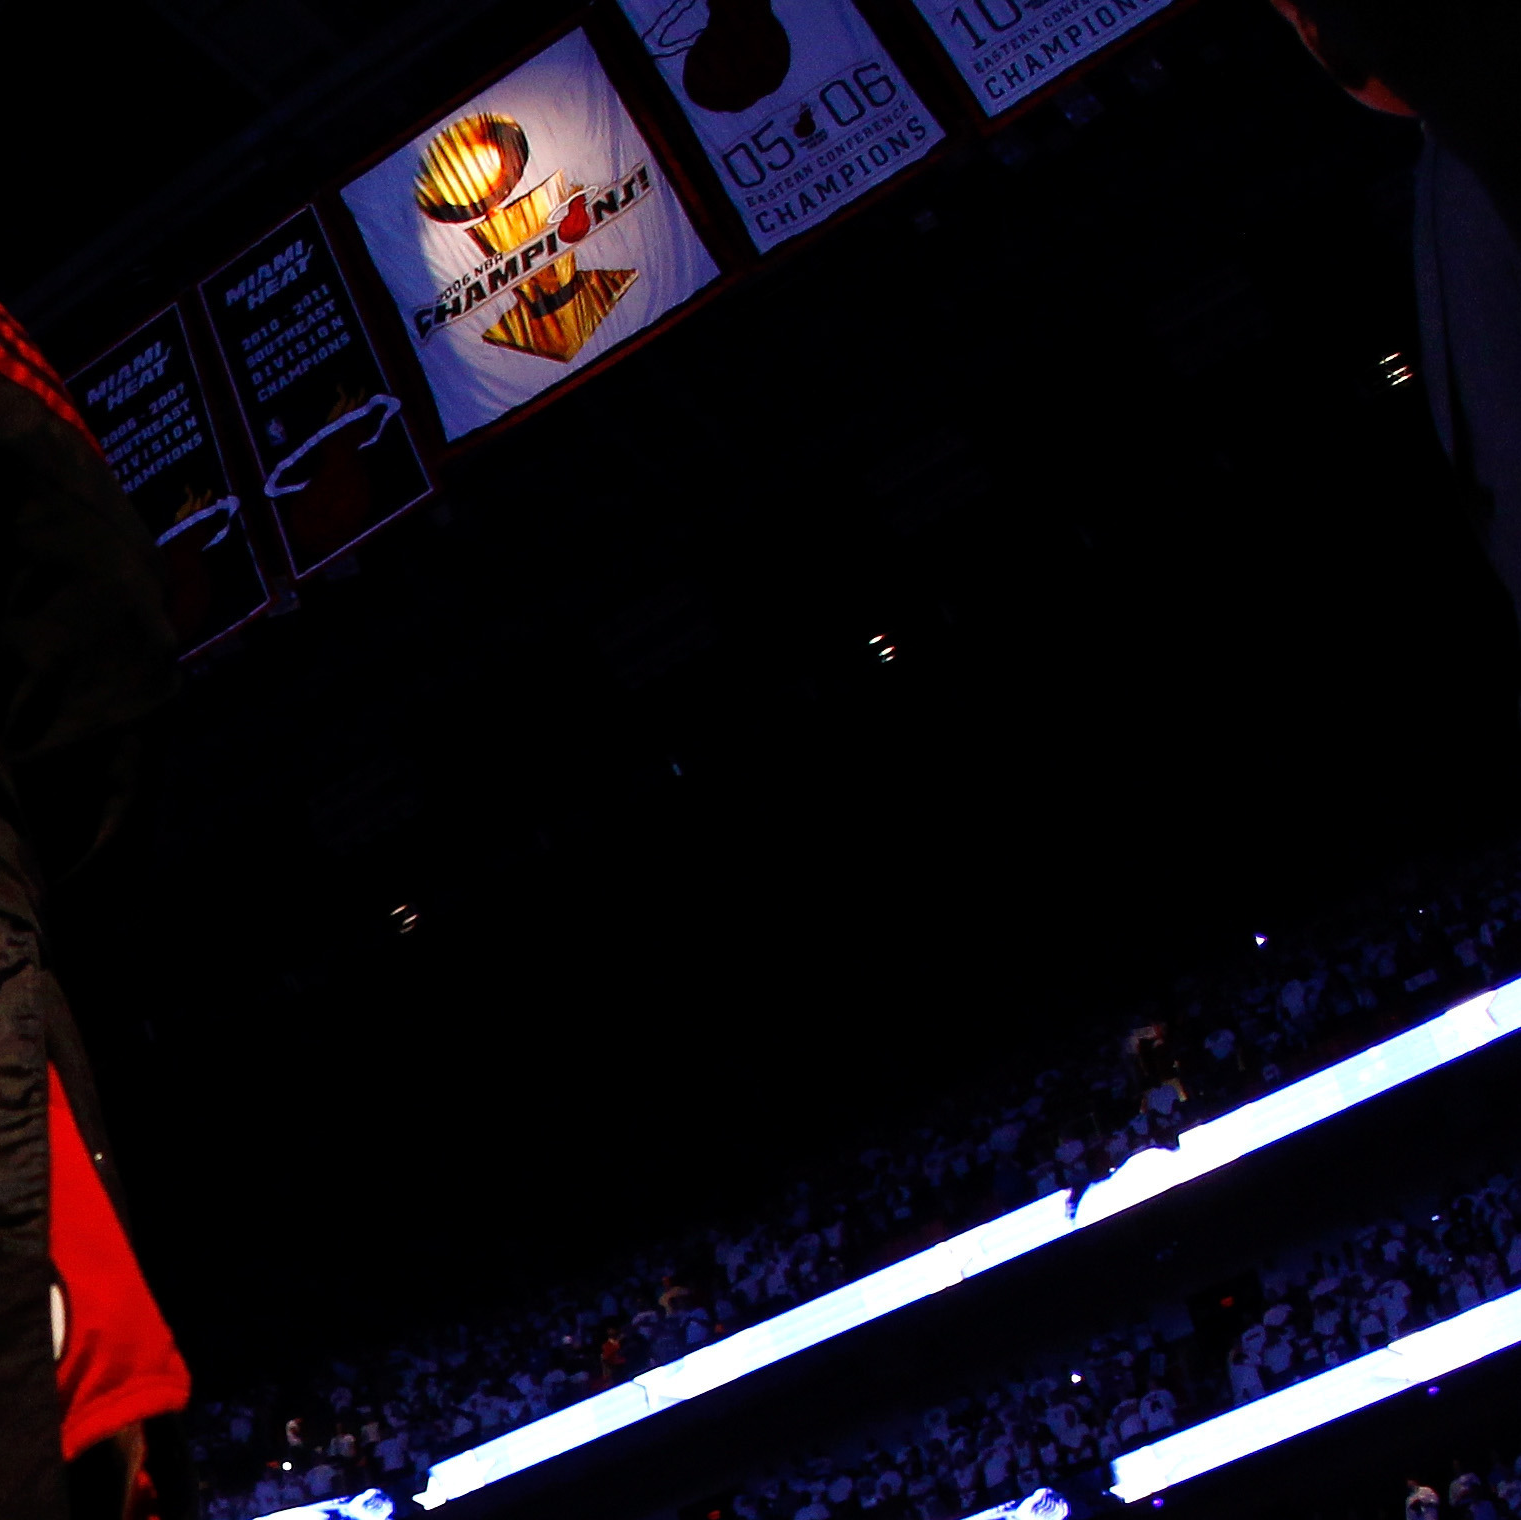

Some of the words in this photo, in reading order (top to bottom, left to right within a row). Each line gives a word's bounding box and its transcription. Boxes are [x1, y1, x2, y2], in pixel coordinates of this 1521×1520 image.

[974, 27, 1039, 73] EASTERN
[985, 0, 1150, 99] CHAMPION
[723, 121, 794, 187] 05
[820, 62, 896, 125] 06
[747, 164, 814, 208] EASTERN
[817, 102, 909, 167] CONFERENCE
[756, 117, 926, 233] CHAMPIONS
[224, 239, 305, 307] MIAMI
[248, 244, 314, 311] HEAT
[473, 252, 504, 277] NBA
[245, 299, 337, 370] SOUTHEAST
[250, 316, 345, 387] DIVISION
[256, 332, 352, 402] CHAMPIONS
[87, 340, 163, 407] MIAMI
[107, 345, 173, 413] HEAT
[122, 432, 204, 494] HAMPIONS
